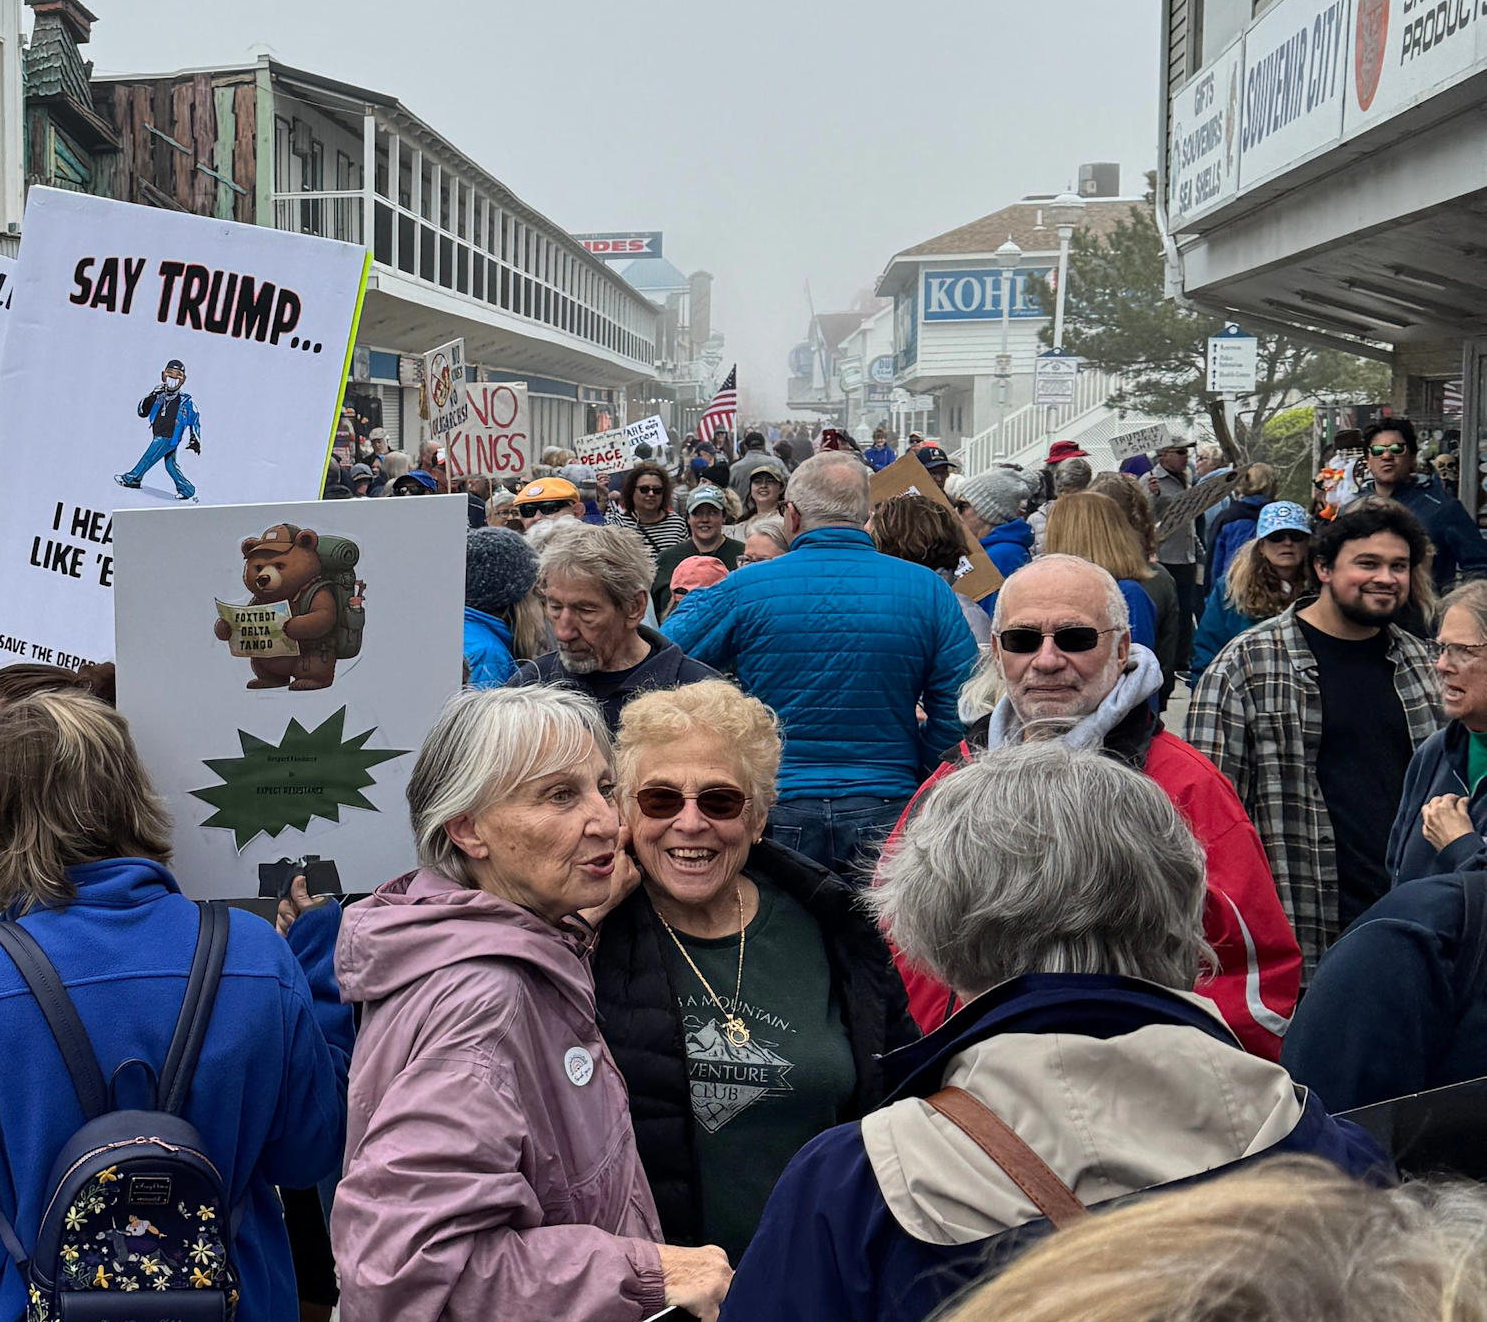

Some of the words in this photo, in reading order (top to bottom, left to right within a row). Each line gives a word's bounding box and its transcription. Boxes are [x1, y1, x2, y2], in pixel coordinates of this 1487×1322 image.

[1195, 71, 1215, 117] GIFTS
[1243, 27, 1307, 153] SOUVENIR
[1182, 110, 1222, 169] SOUVENIRS
[1179, 180, 1193, 215] SEA
[1195, 159, 1222, 206] SHELLS
[69, 257, 146, 314] SAY
[157, 260, 322, 353] TRUMP...
[466, 386, 518, 429] NO
[445, 430, 526, 478] KINGS
[580, 449, 623, 466] PEACE
[53, 502, 64, 531] I
[30, 536, 86, 578] LIKE
[235, 611, 276, 623] FOXTROT
[241, 626, 271, 637] DELTA
[31, 644, 53, 663] THE
[240, 639, 273, 651] TANGO
[687, 995, 698, 1007] A
[701, 994, 790, 1031] MOUNTAIN
[691, 1083, 738, 1100] CLUB
